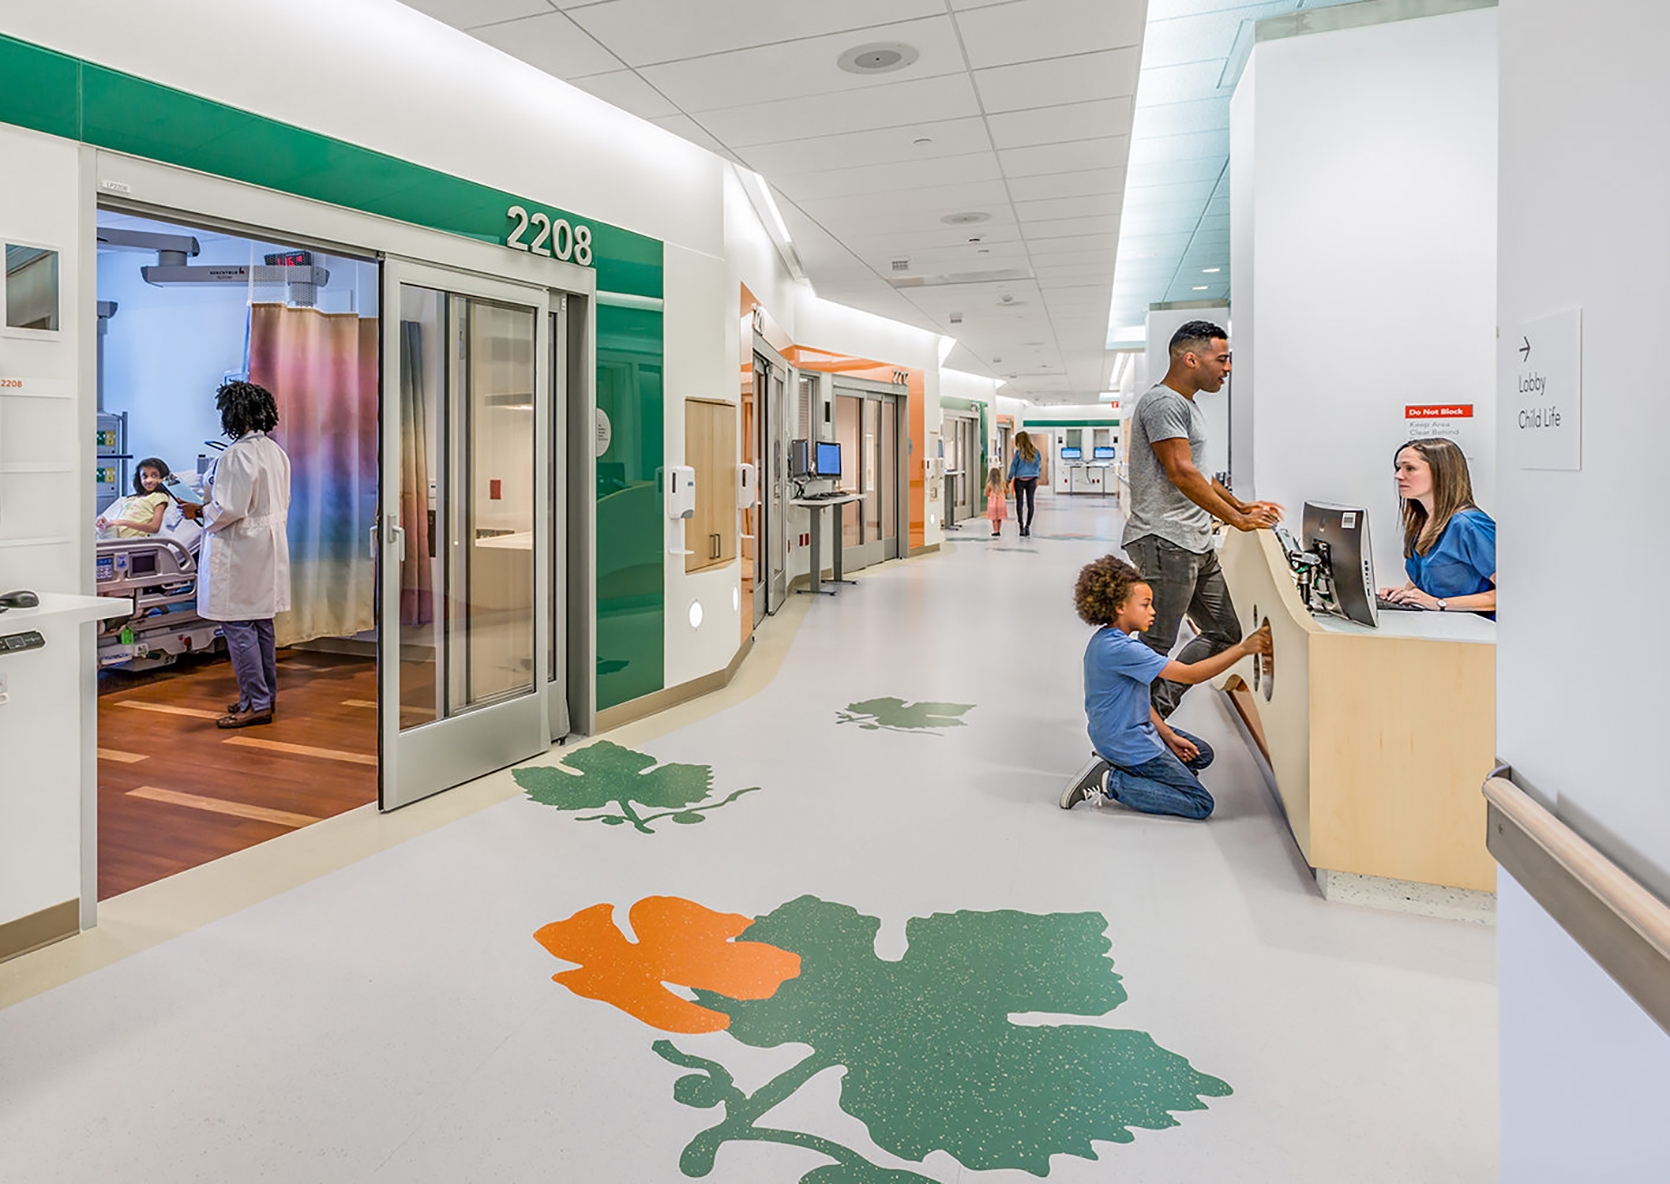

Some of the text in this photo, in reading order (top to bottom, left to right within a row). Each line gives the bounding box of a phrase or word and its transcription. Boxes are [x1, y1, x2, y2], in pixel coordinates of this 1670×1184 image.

[507, 205, 593, 267] 2208
[0, 379, 23, 388] 2208
[1518, 371, 1547, 396] Lobby
[1440, 407, 1463, 415] Block
[1518, 405, 1561, 429] Child Life
[1431, 428, 1460, 436] Behind
